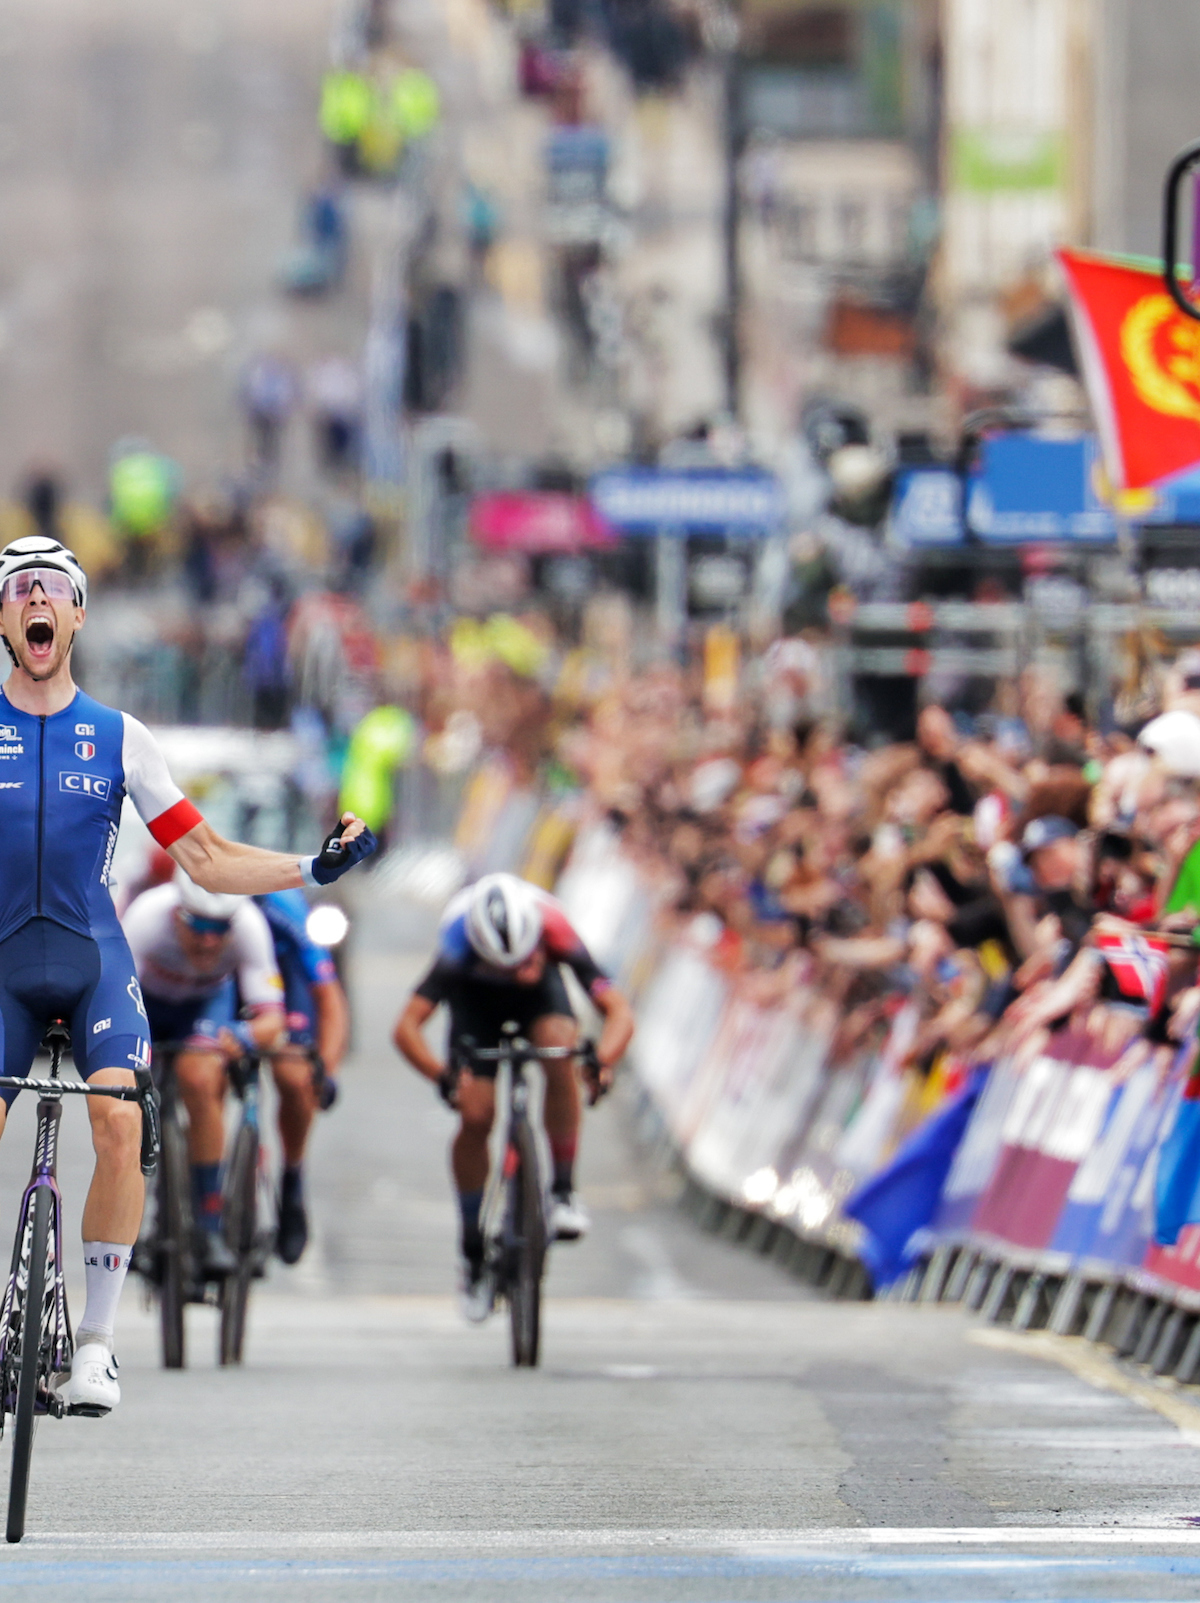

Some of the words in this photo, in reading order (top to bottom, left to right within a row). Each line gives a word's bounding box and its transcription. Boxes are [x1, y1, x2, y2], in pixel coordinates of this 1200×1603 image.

[65, 775, 106, 795] CIC
[99, 821, 118, 887] FRANCE
[36, 1117, 47, 1167] CANYON
[45, 1119, 56, 1167] CANYON
